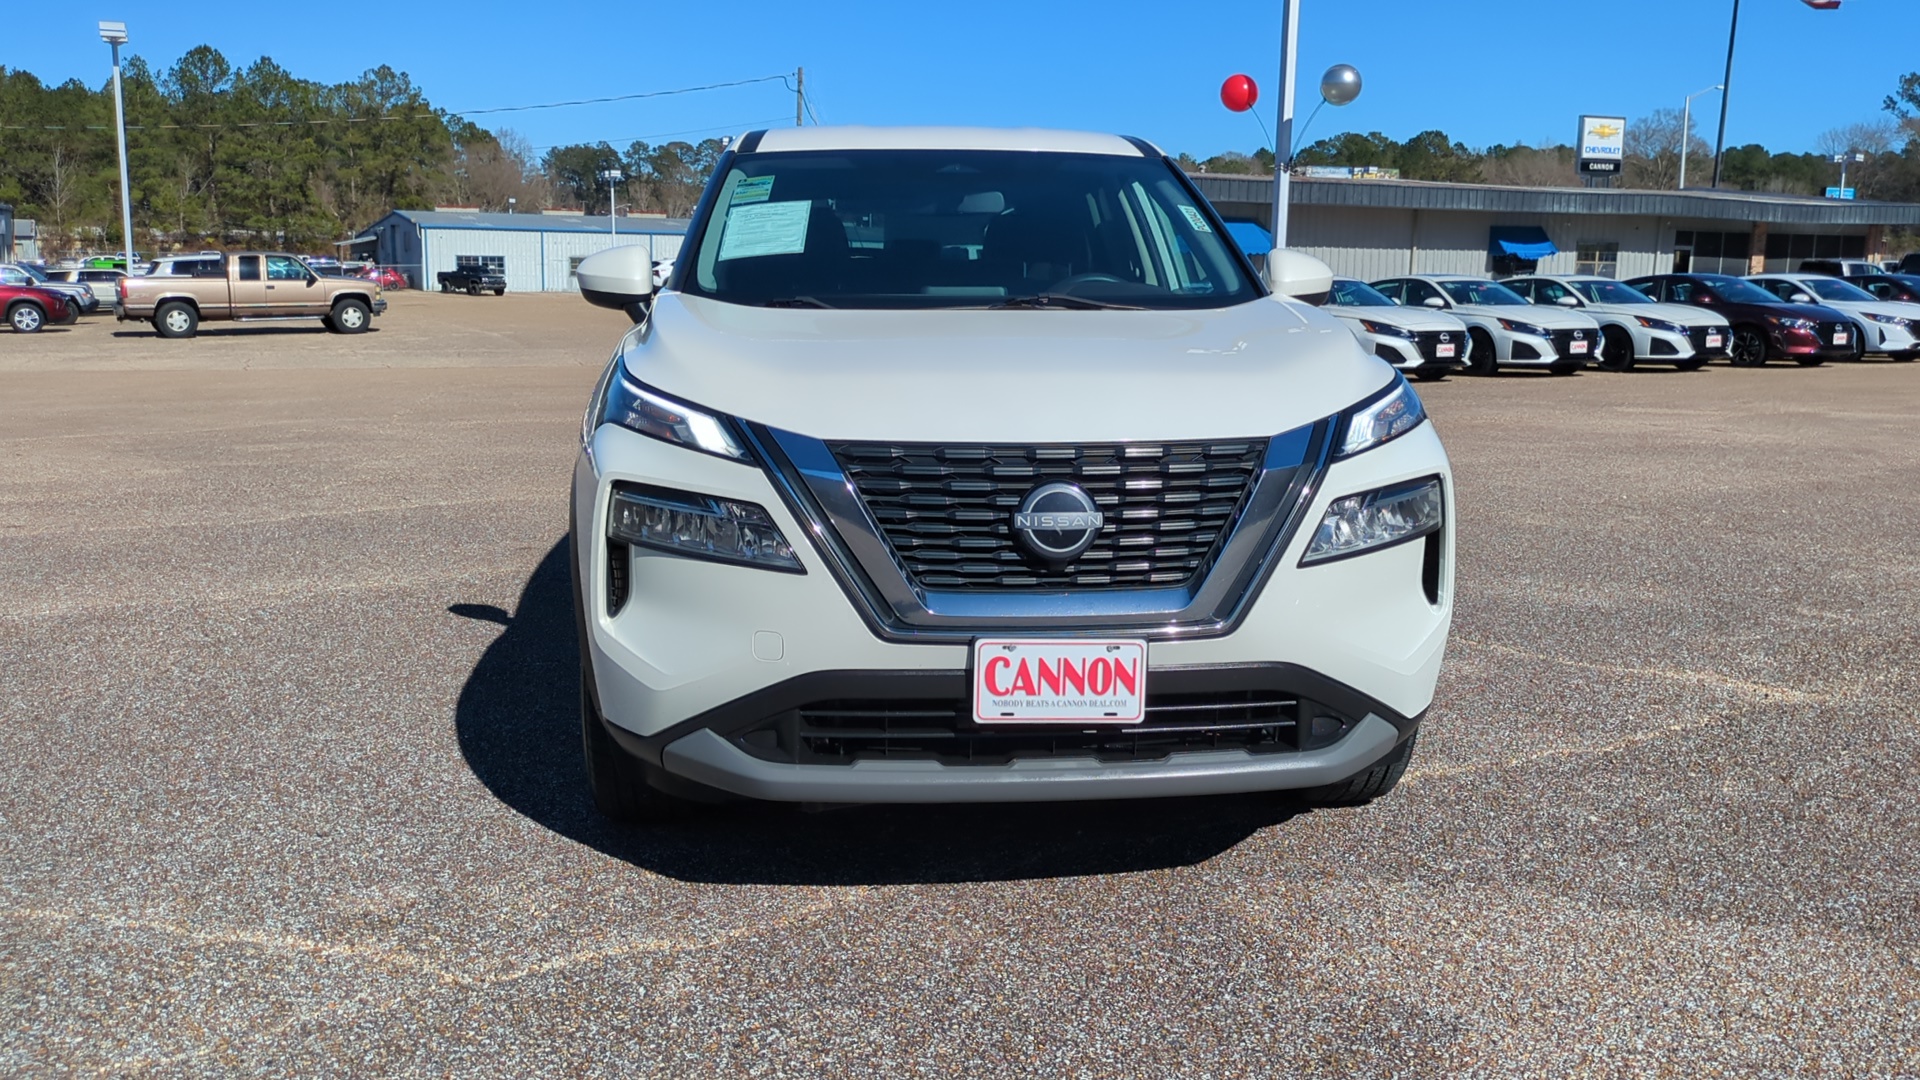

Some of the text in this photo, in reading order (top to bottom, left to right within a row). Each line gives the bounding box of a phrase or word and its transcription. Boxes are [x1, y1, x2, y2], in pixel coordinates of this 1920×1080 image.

[1585, 146, 1620, 154] CHEVROLET
[1589, 162, 1614, 170] CANNON
[1017, 515, 1100, 527] NISSAN
[984, 656, 1137, 697] CANNON
[992, 699, 1127, 708] NOBODY BEATS A CANNON DEAL.COM
